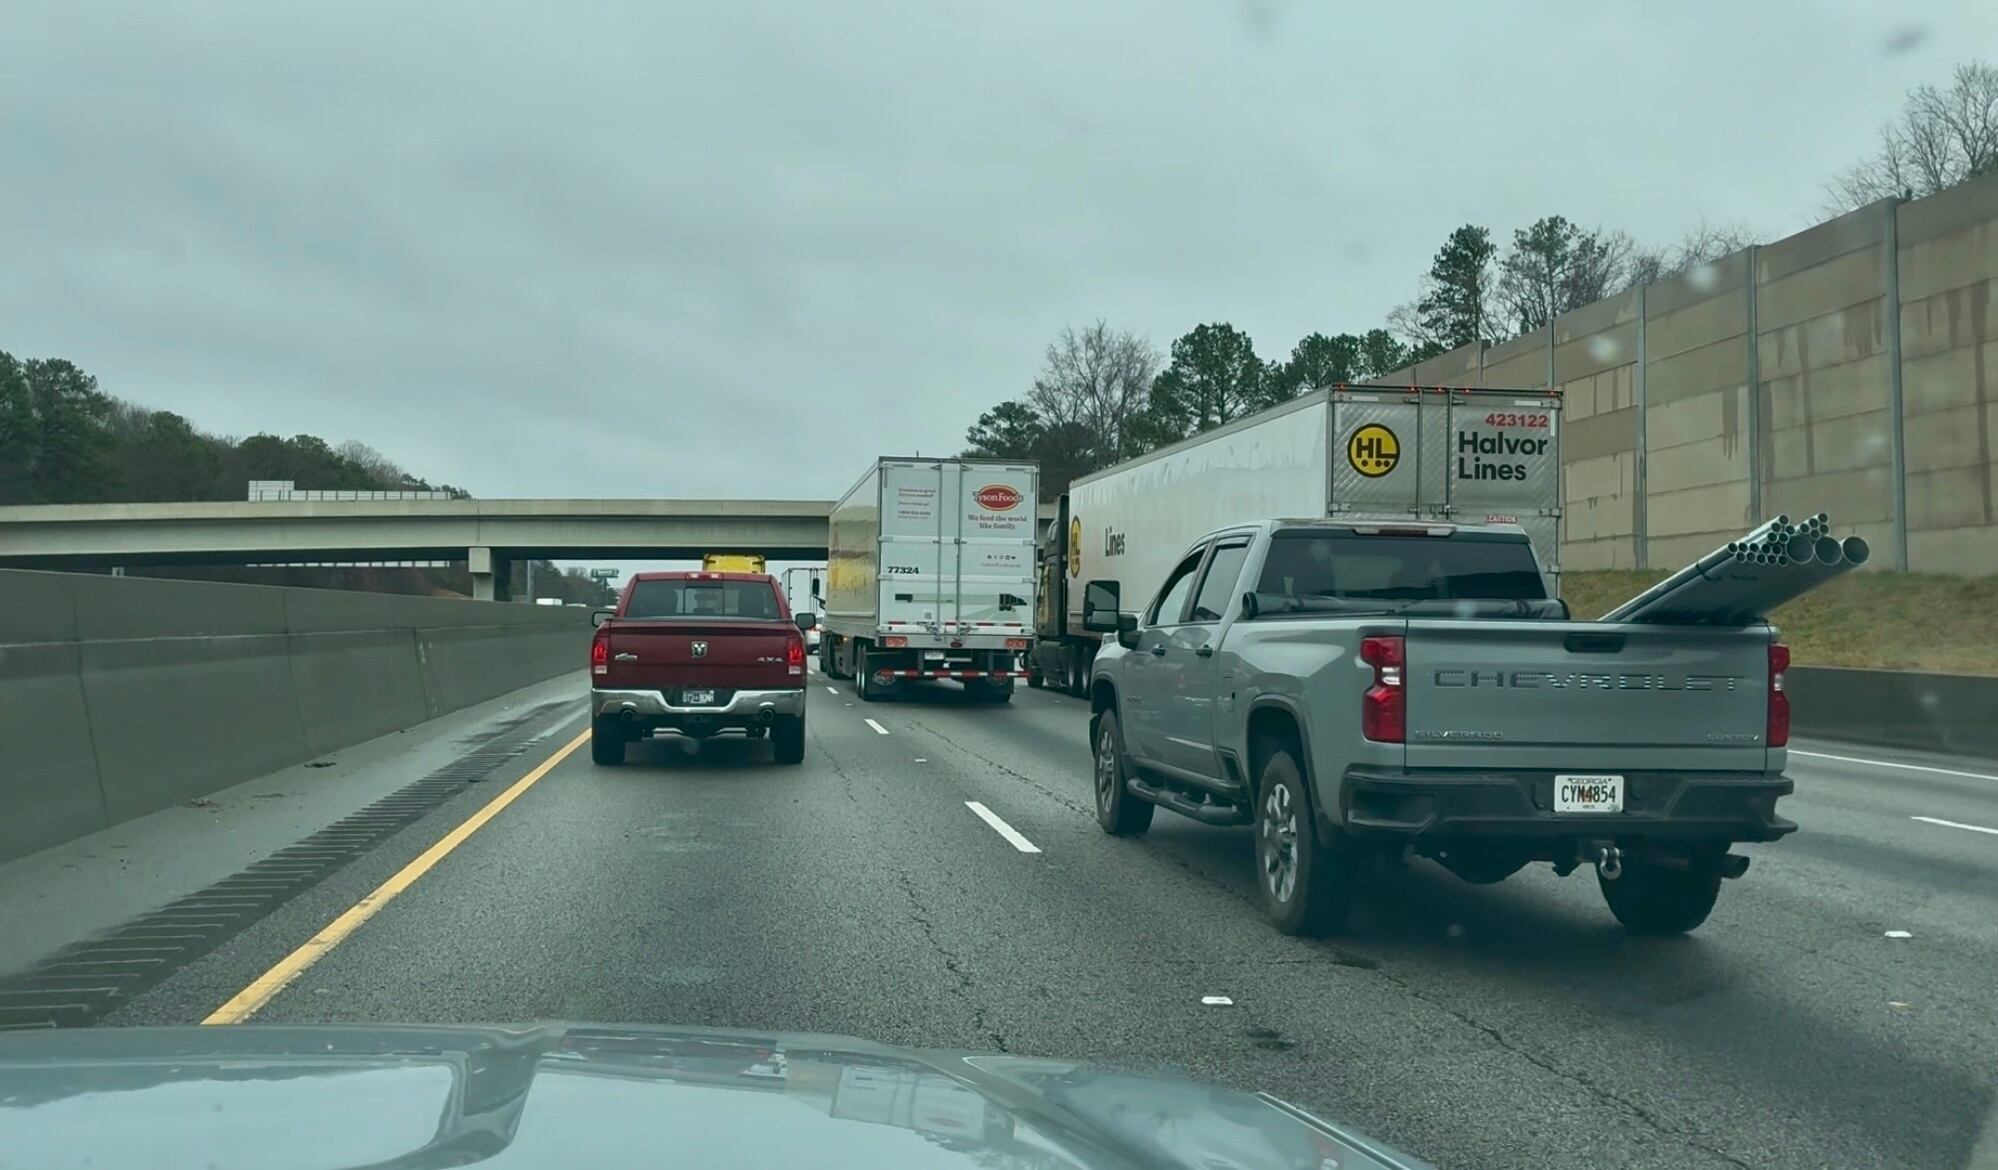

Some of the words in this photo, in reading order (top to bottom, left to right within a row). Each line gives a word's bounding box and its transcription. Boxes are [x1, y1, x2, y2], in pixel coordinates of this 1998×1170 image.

[1485, 413, 1548, 428] 423122
[1356, 437, 1398, 460] HL
[1458, 431, 1548, 456] Halvor
[1458, 456, 1527, 481] Lines
[1105, 526, 1126, 557] Lines
[887, 566, 920, 575] 77324
[1434, 670, 1745, 691] CHEVROLET
[1414, 730, 1504, 740] SILVERADO
[1571, 777, 1608, 785] GEORGIA
